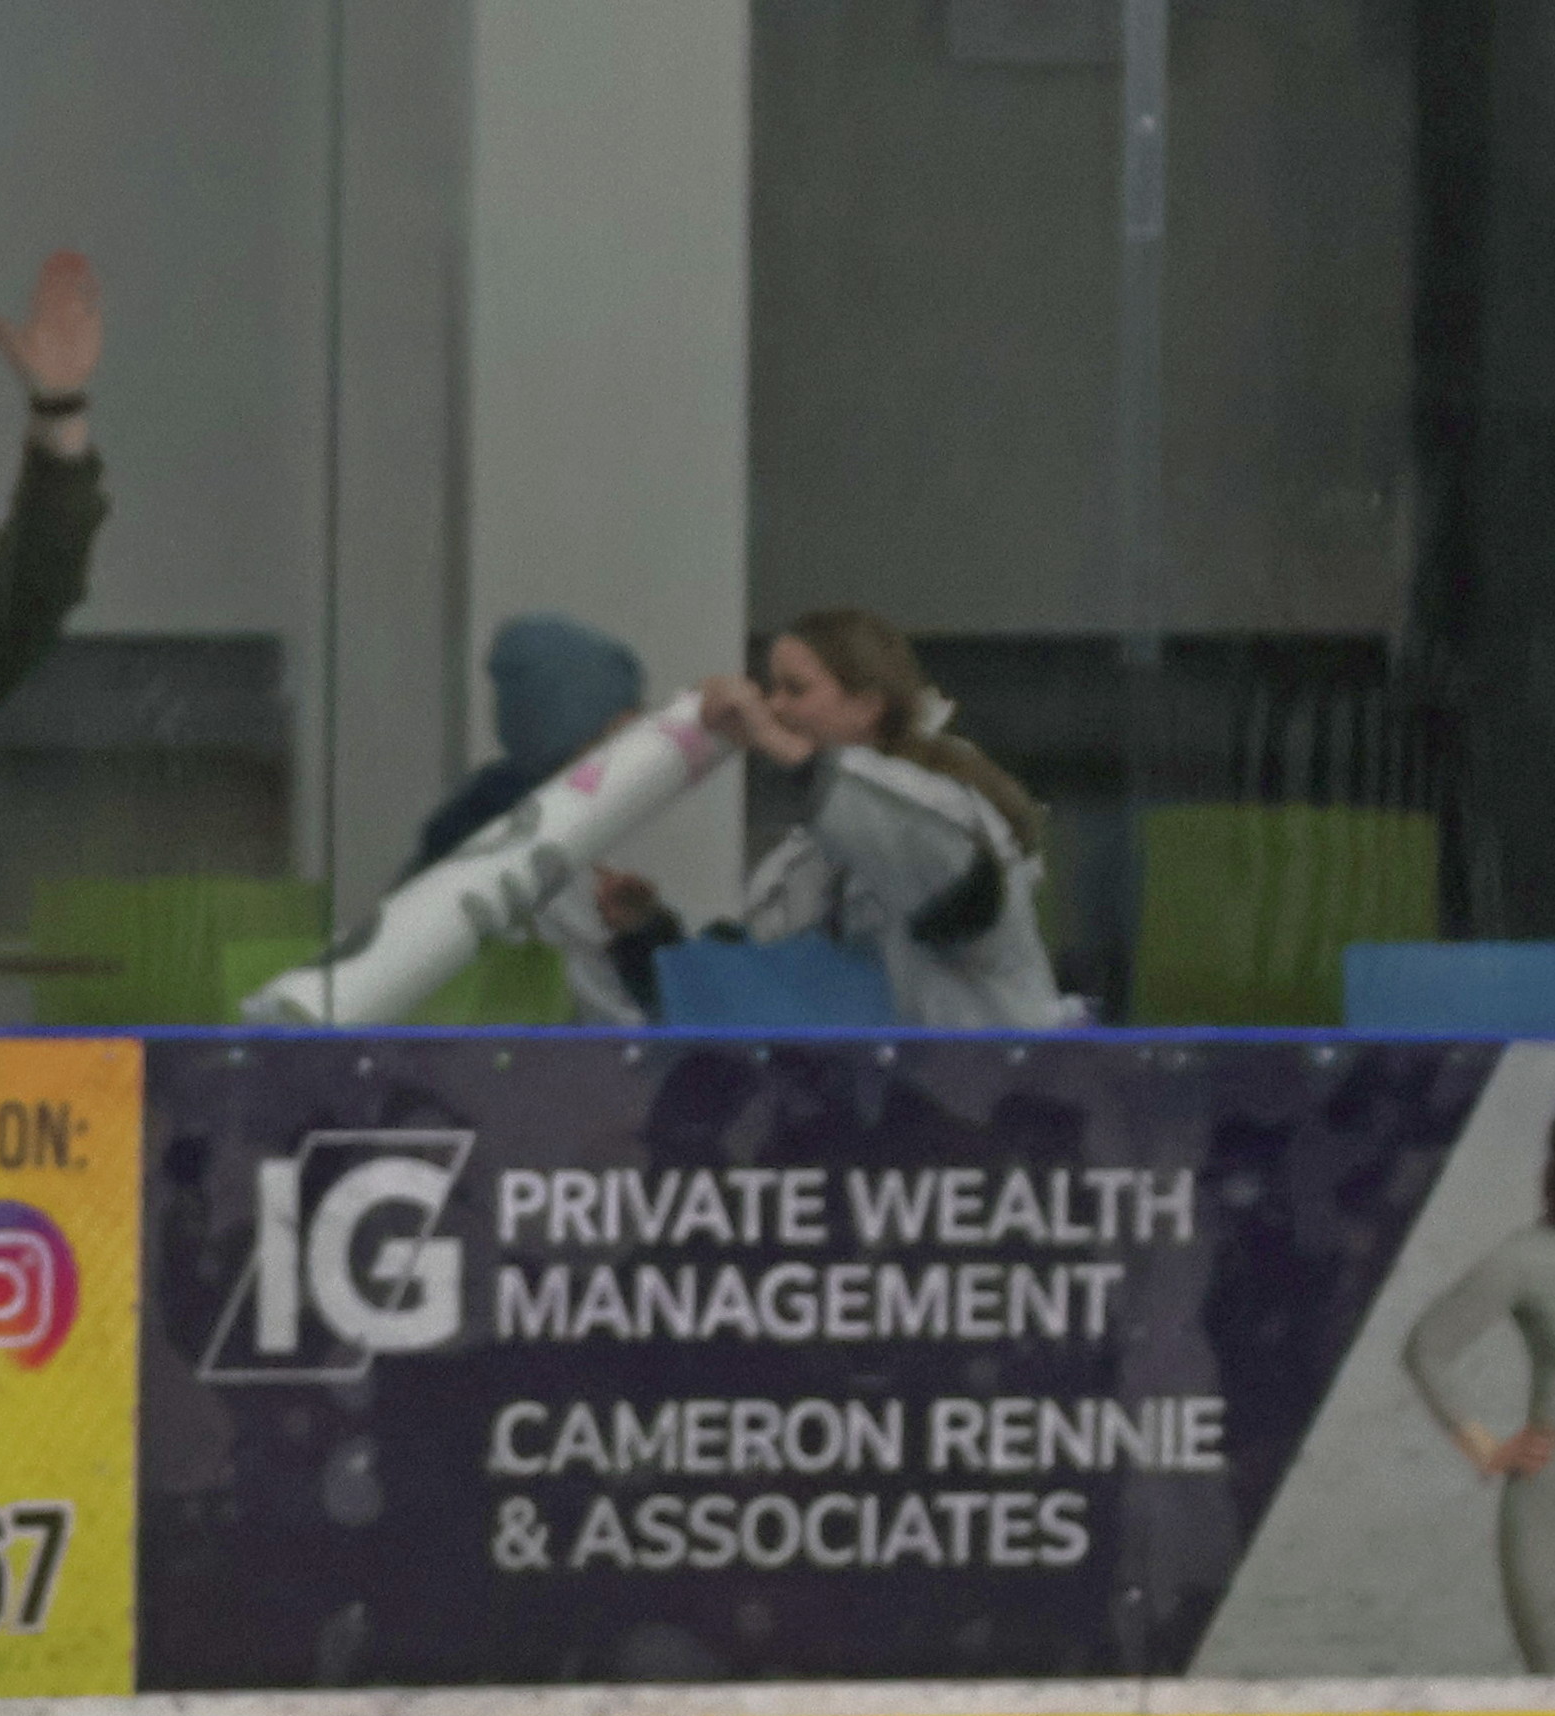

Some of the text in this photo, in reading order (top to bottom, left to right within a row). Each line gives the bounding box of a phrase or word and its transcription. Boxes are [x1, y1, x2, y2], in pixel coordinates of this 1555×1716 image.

[254, 1156, 1193, 1353] IG PRIVATE WEALTH
[496, 1262, 1125, 1341] MANAGEMENT
[491, 1397, 1227, 1474] CAMERON RENNIE
[493, 1492, 1091, 1570] & ASSOCIATES
